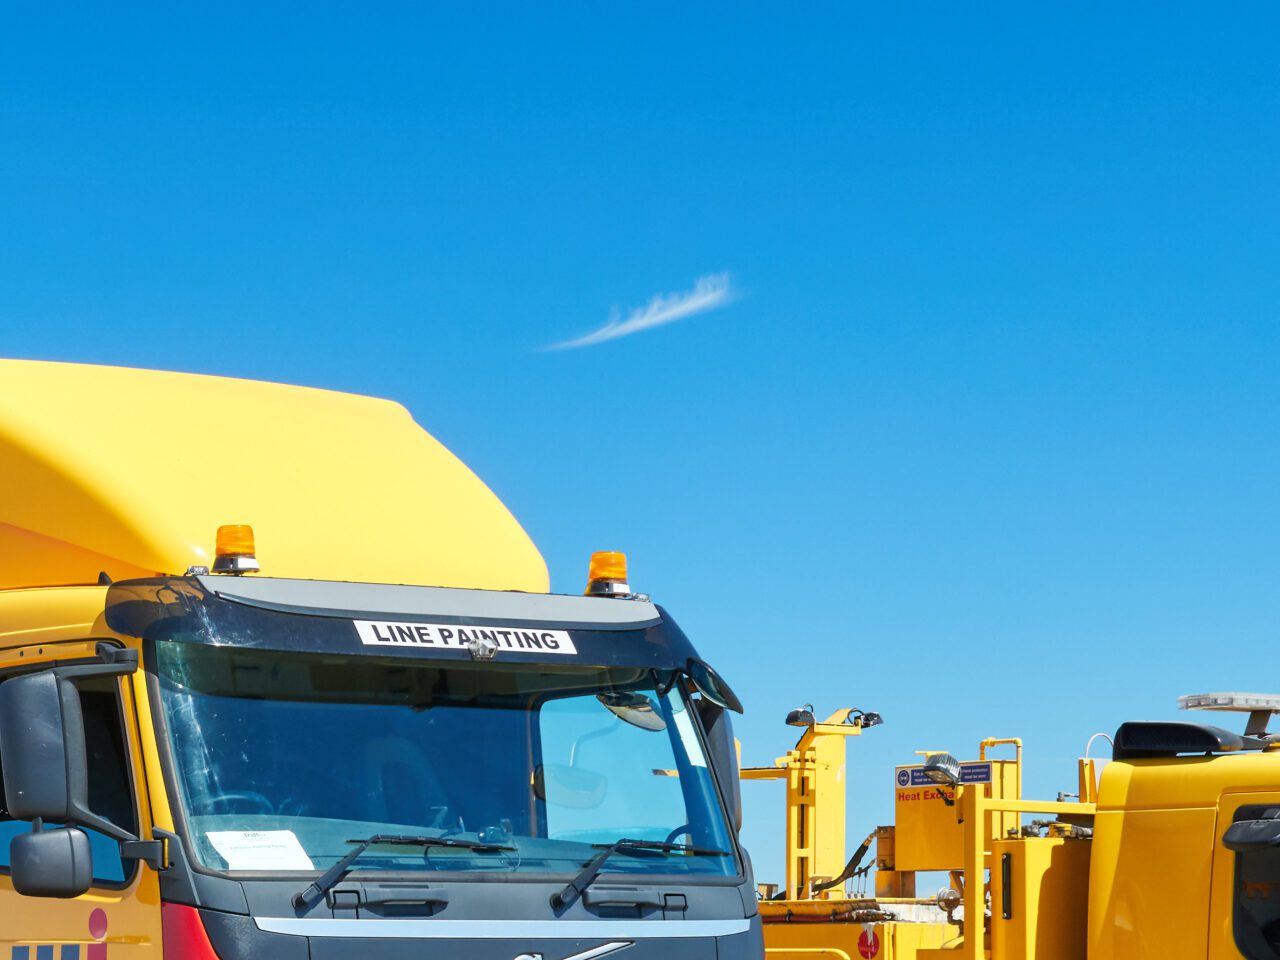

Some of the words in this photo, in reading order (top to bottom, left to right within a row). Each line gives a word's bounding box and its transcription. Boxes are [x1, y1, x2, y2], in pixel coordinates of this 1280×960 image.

[371, 624, 434, 643] LINE
[438, 627, 560, 650] PAINTING
[898, 792, 920, 801] Heat
